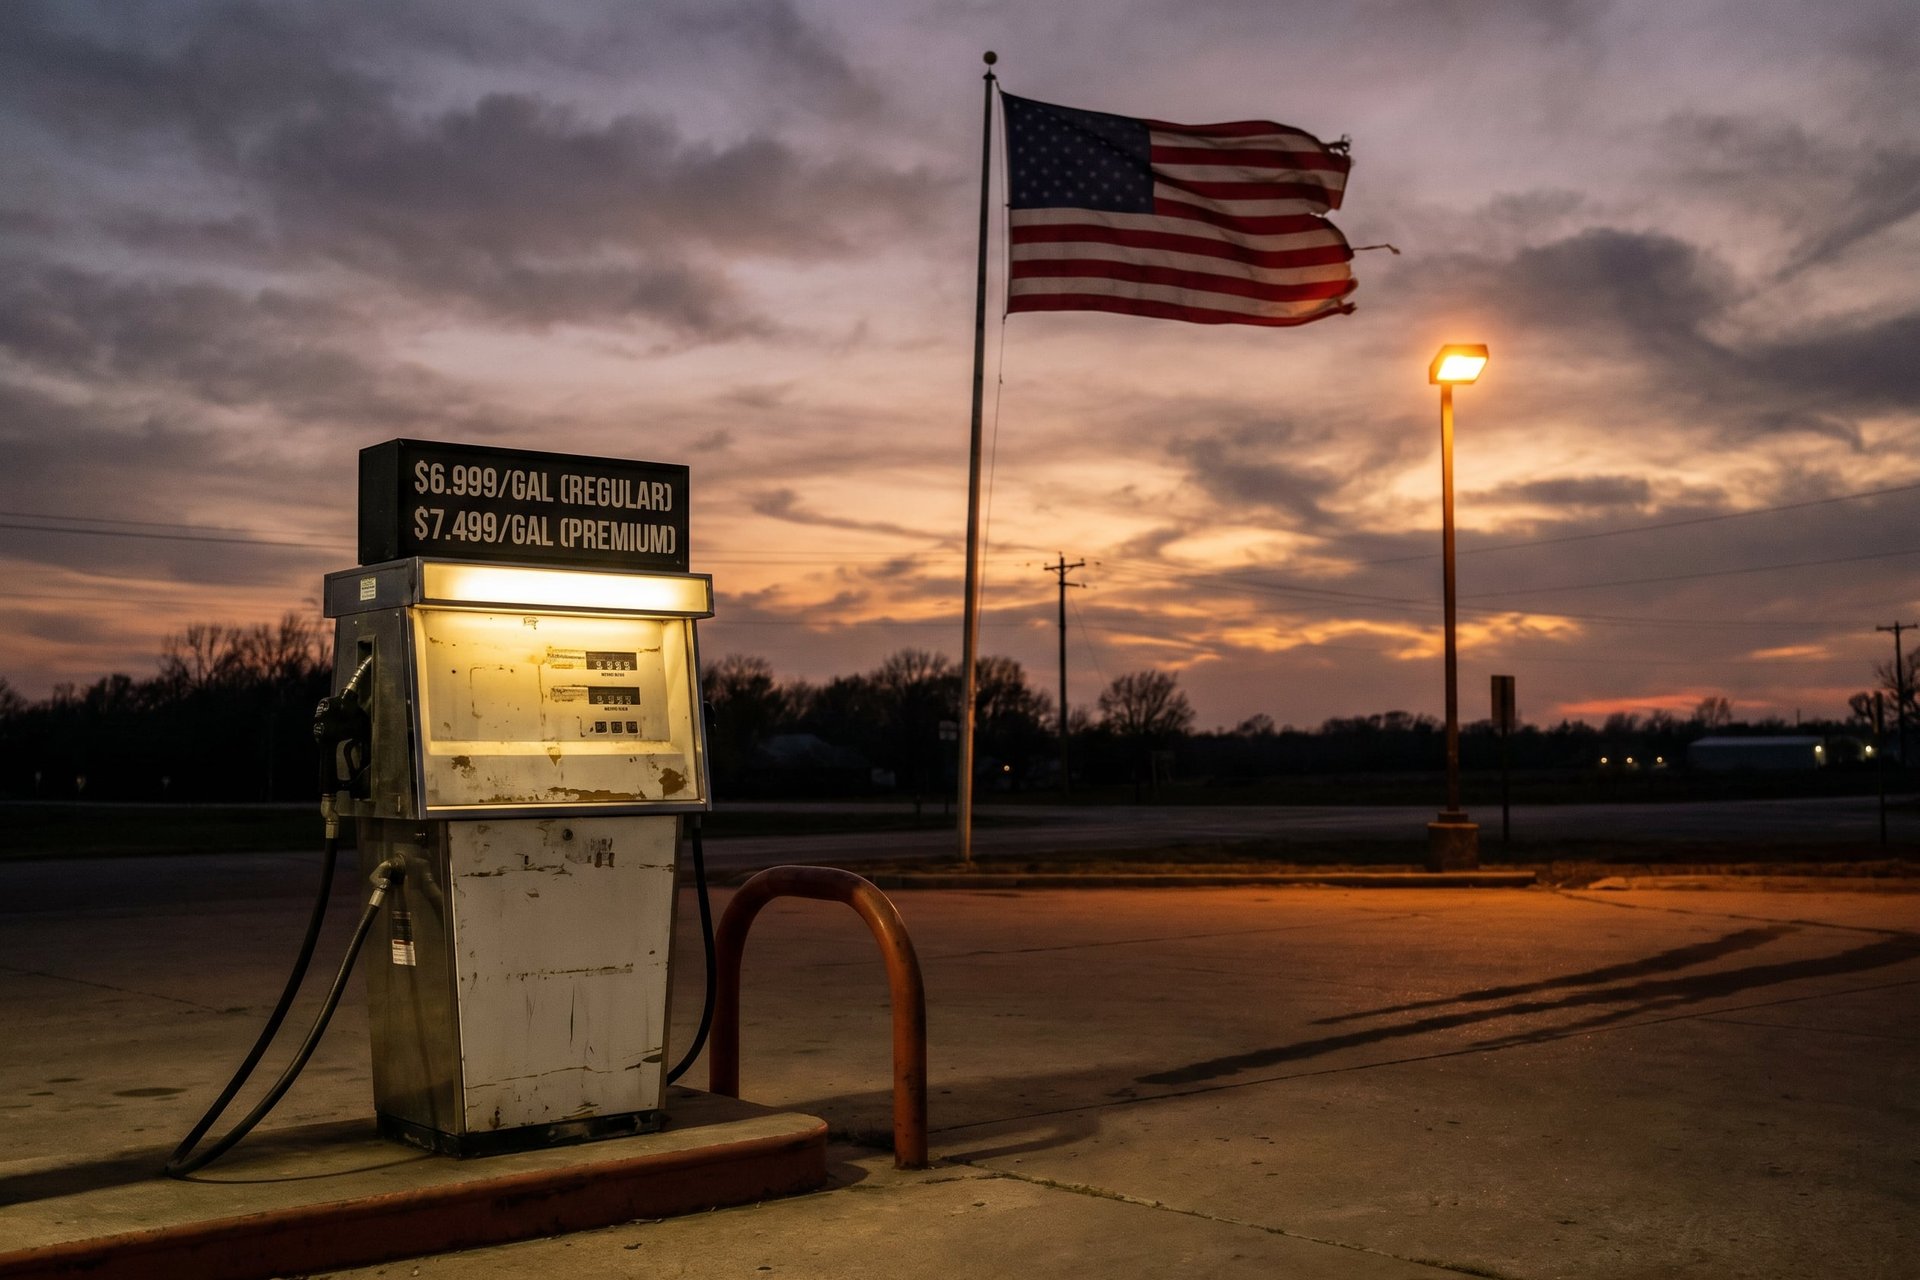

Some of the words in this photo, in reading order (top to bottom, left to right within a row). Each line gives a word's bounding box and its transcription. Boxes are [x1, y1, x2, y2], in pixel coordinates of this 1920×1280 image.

[414, 460, 554, 502] $6.999/GAL
[560, 474, 672, 511] (REGULAR)
[414, 506, 554, 546] $7.499/GAL
[560, 518, 676, 554] (PREMIUM)
